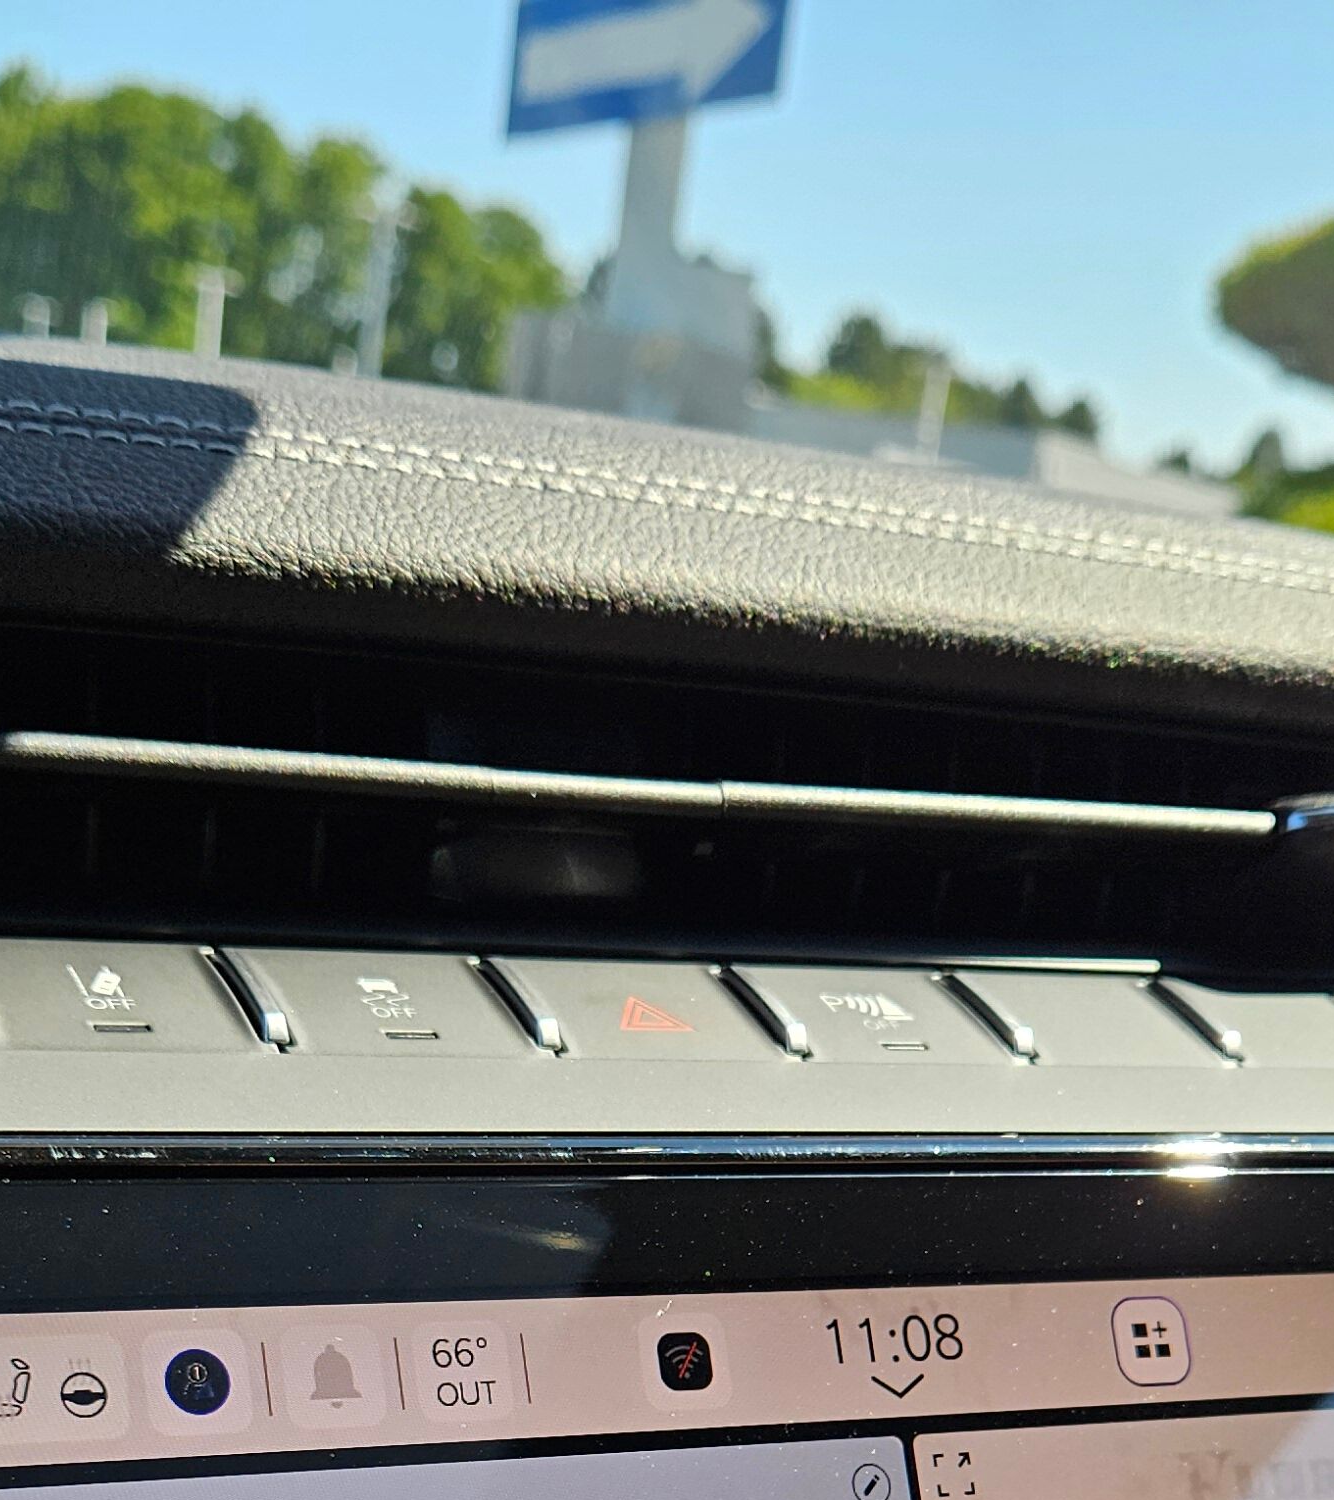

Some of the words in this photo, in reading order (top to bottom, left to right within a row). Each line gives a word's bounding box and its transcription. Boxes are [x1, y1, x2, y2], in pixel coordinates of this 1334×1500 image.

[86, 998, 136, 1010] OFF
[371, 1007, 417, 1019] OFF
[826, 1314, 964, 1365] 11:08
[432, 1337, 487, 1369] 66°
[437, 1380, 496, 1406] OUT
